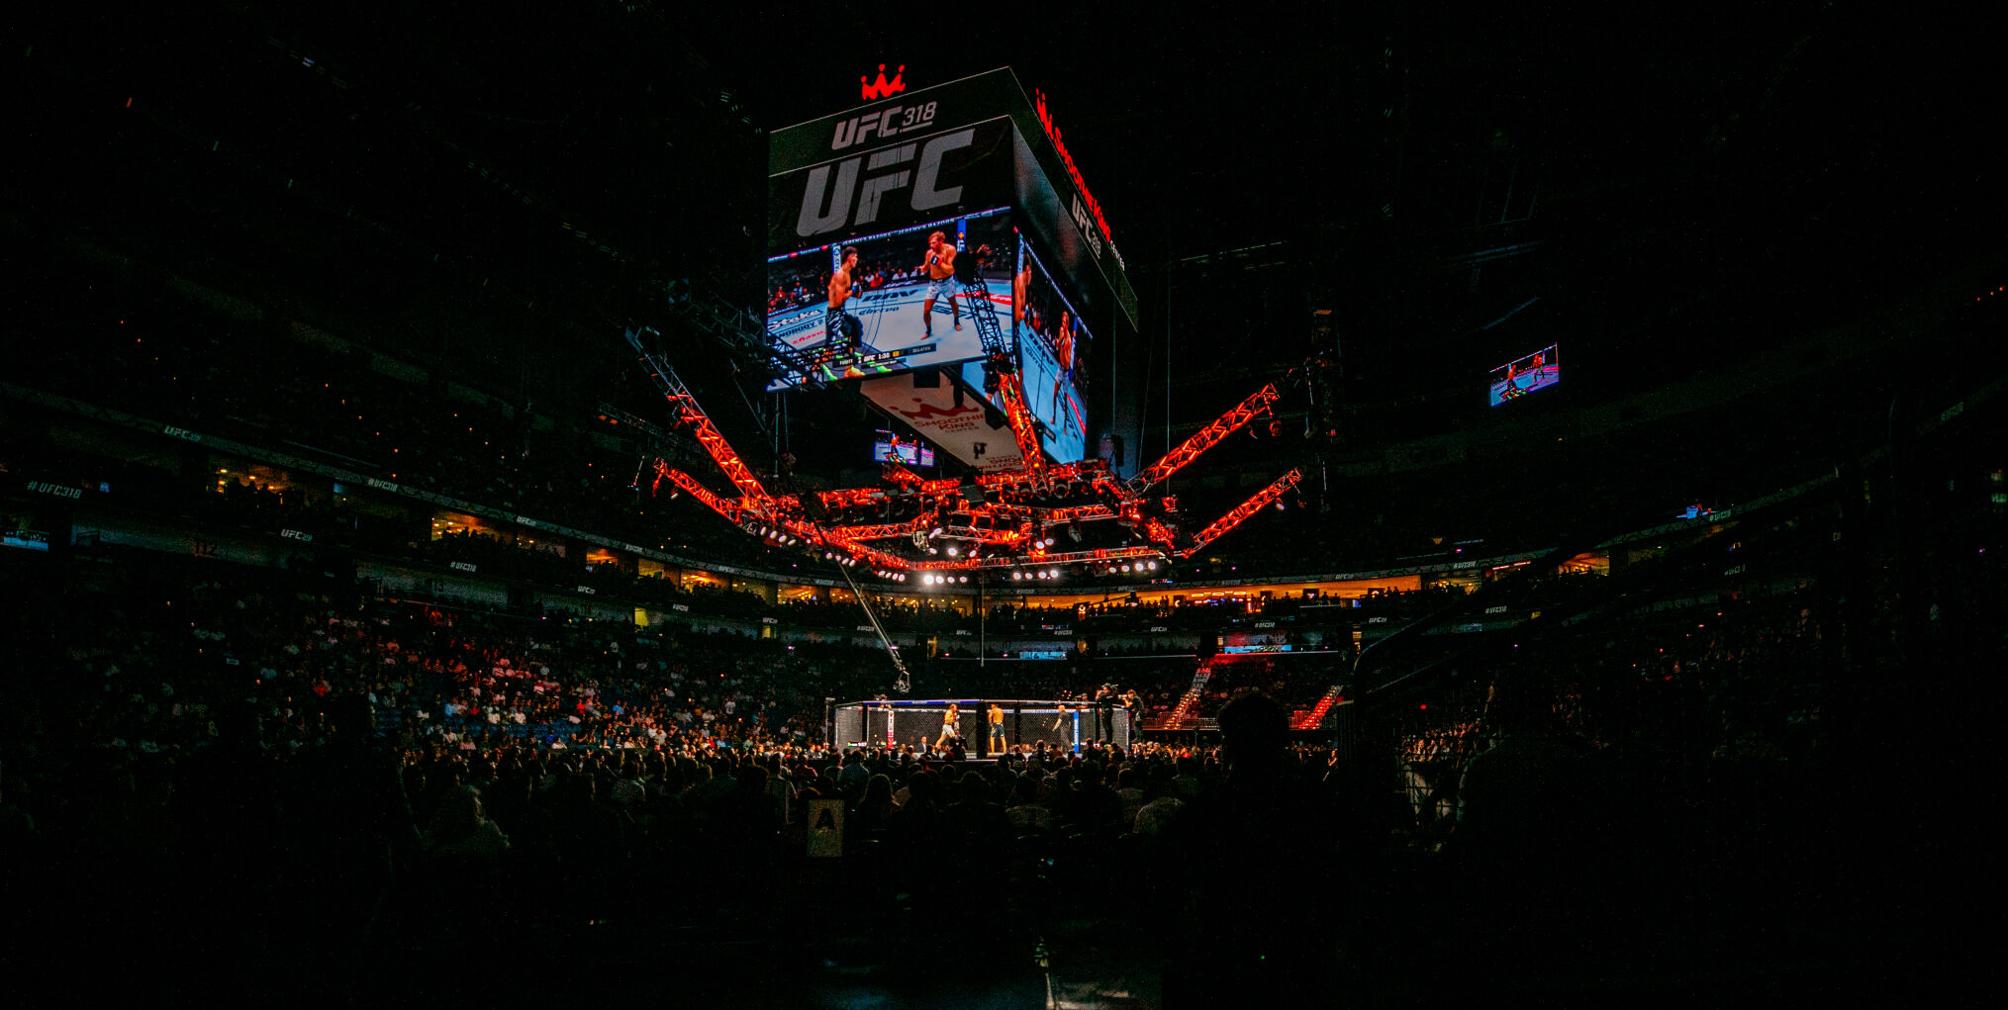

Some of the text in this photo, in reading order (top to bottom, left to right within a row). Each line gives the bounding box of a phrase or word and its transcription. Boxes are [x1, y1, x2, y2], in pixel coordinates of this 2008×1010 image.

[832, 101, 937, 150] UFC 318
[796, 128, 975, 238] UFC
[814, 808, 835, 829] A
